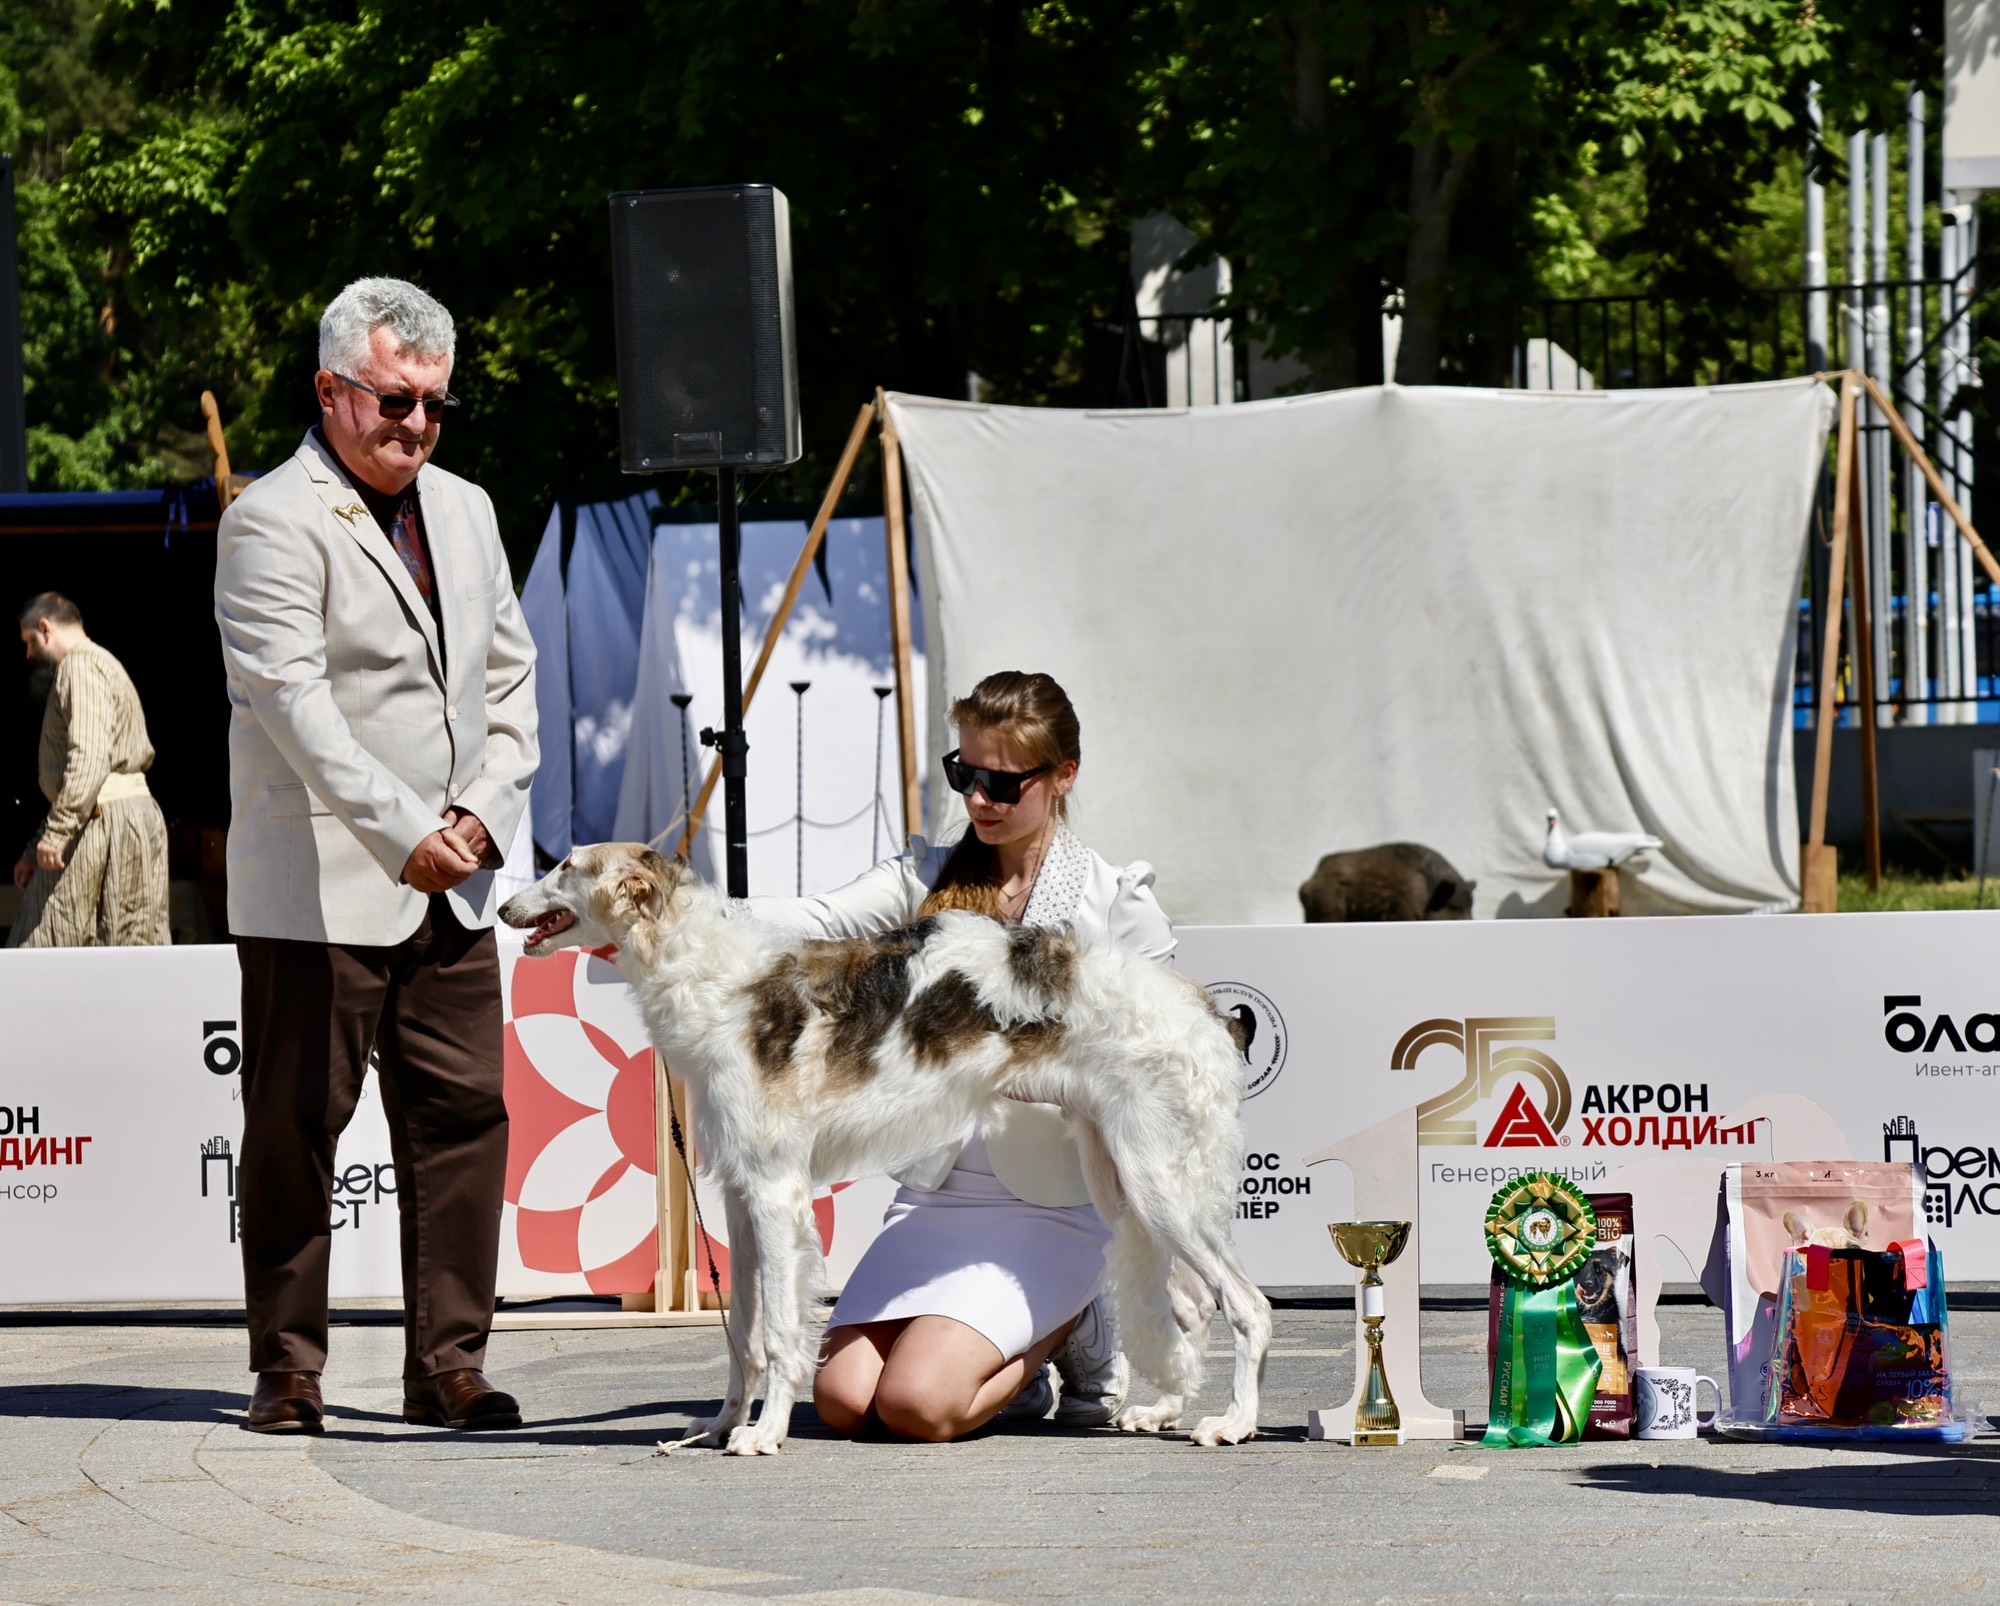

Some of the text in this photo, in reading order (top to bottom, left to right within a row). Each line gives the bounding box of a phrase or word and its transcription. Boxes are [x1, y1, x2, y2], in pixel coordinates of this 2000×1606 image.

[1232, 987, 1254, 999] КЛУБ
[1253, 996, 1278, 1029] ПОРОДЫ
[1580, 1083, 1709, 1114] АКРОН
[1581, 1114, 1766, 1151] ХОЛДИНГ
[1431, 1160, 1607, 1187] Генераный
[1755, 1170, 1762, 1178] 3
[1597, 1217, 1620, 1228] 100%
[1499, 1360, 1512, 1407] РУССКАЯ
[1876, 1370, 1887, 1378] НА
[1888, 1369, 1916, 1378] ПЕРВЫЙ
[1905, 1378, 1938, 1399] 10%
[1595, 1418, 1602, 1427] 2
